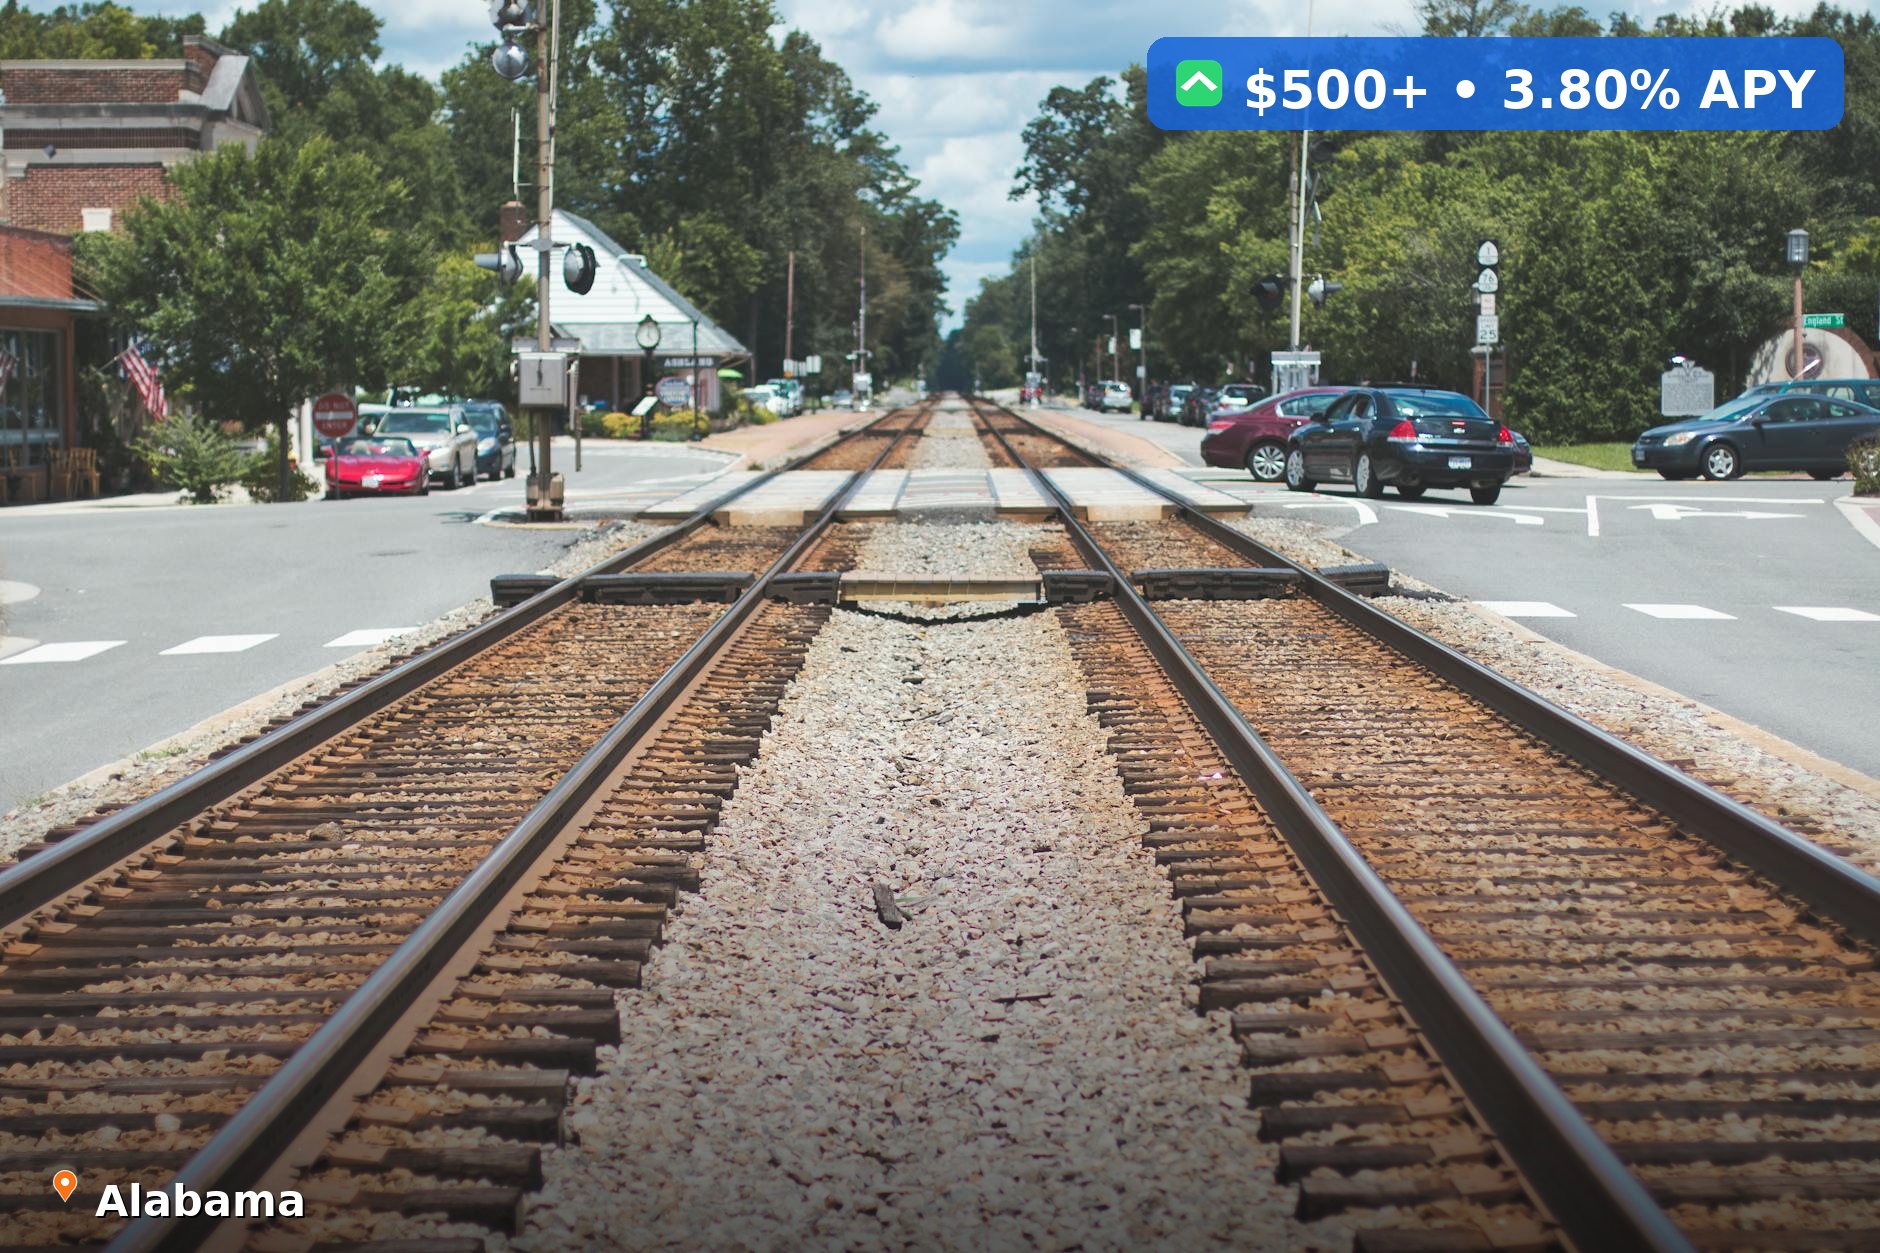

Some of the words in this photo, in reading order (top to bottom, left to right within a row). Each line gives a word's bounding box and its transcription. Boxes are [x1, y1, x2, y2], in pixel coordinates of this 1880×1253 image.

[1803, 315, 1832, 327] England
[1836, 315, 1844, 325] St
[1480, 330, 1497, 340] 25
[664, 357, 714, 368] ASHLAND
